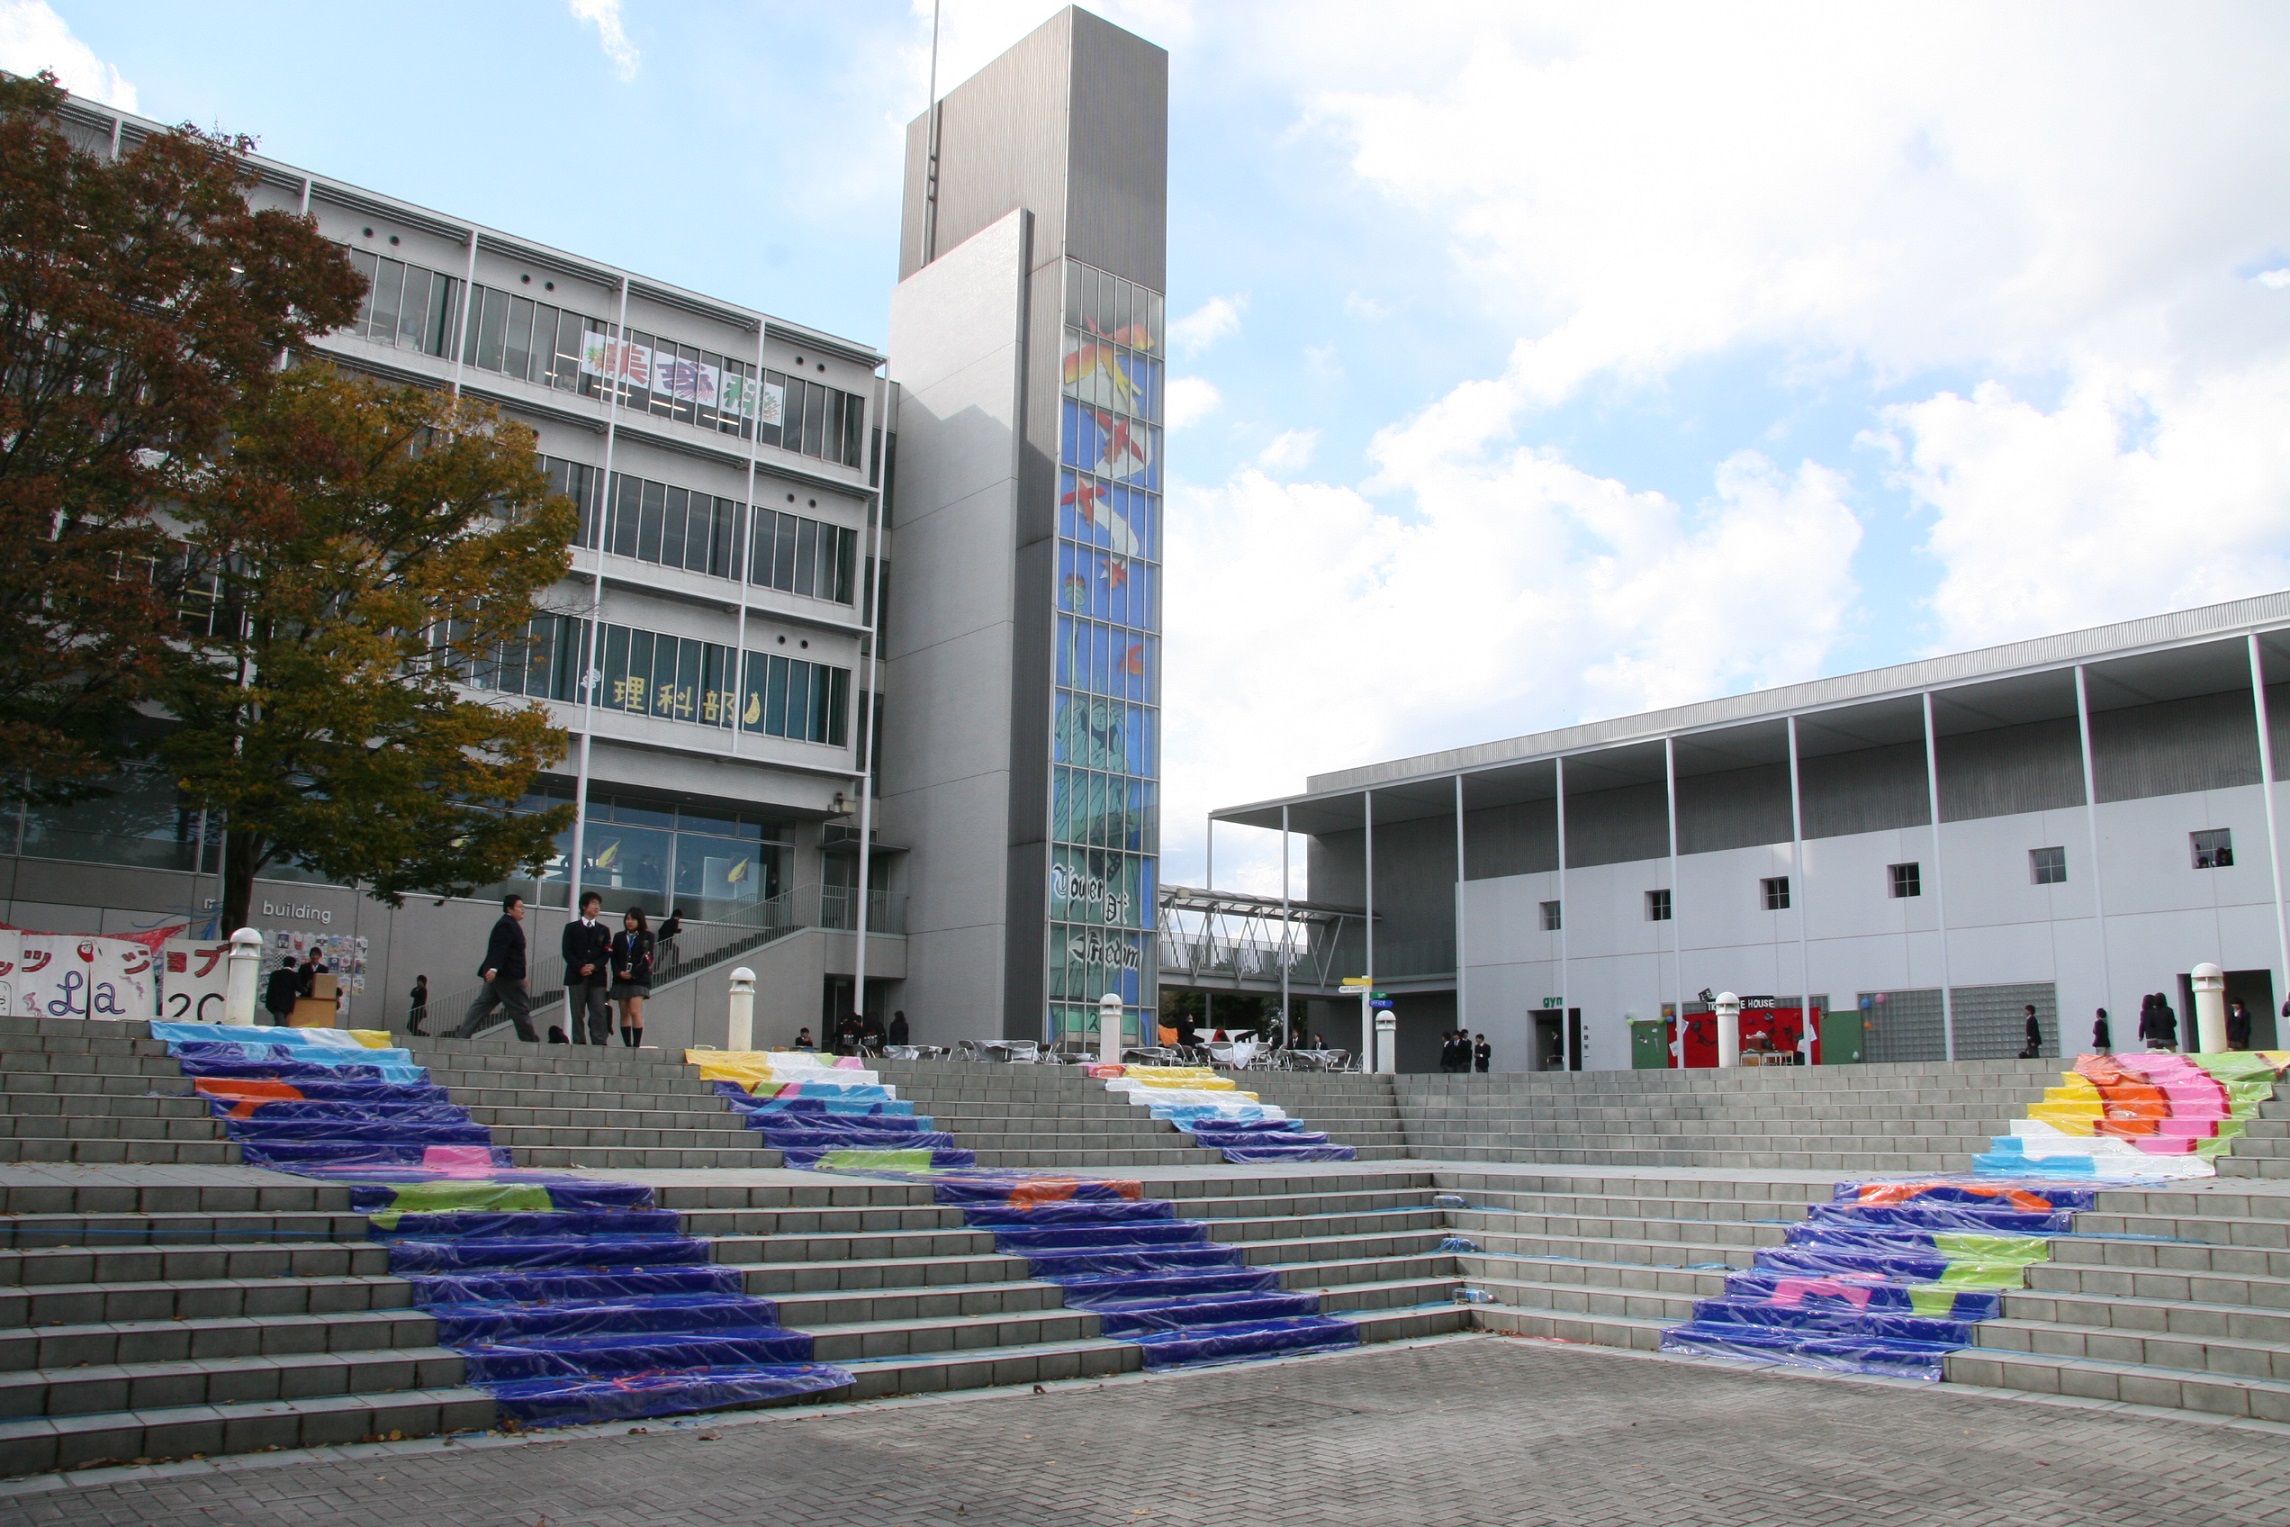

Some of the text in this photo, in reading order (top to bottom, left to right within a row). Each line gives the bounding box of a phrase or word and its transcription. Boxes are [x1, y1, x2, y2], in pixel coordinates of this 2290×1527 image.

[613, 676, 736, 724] 理科部
[1053, 864, 1104, 901] Tower
[263, 900, 332, 925] building
[1747, 999, 1775, 1009] HOUSE
